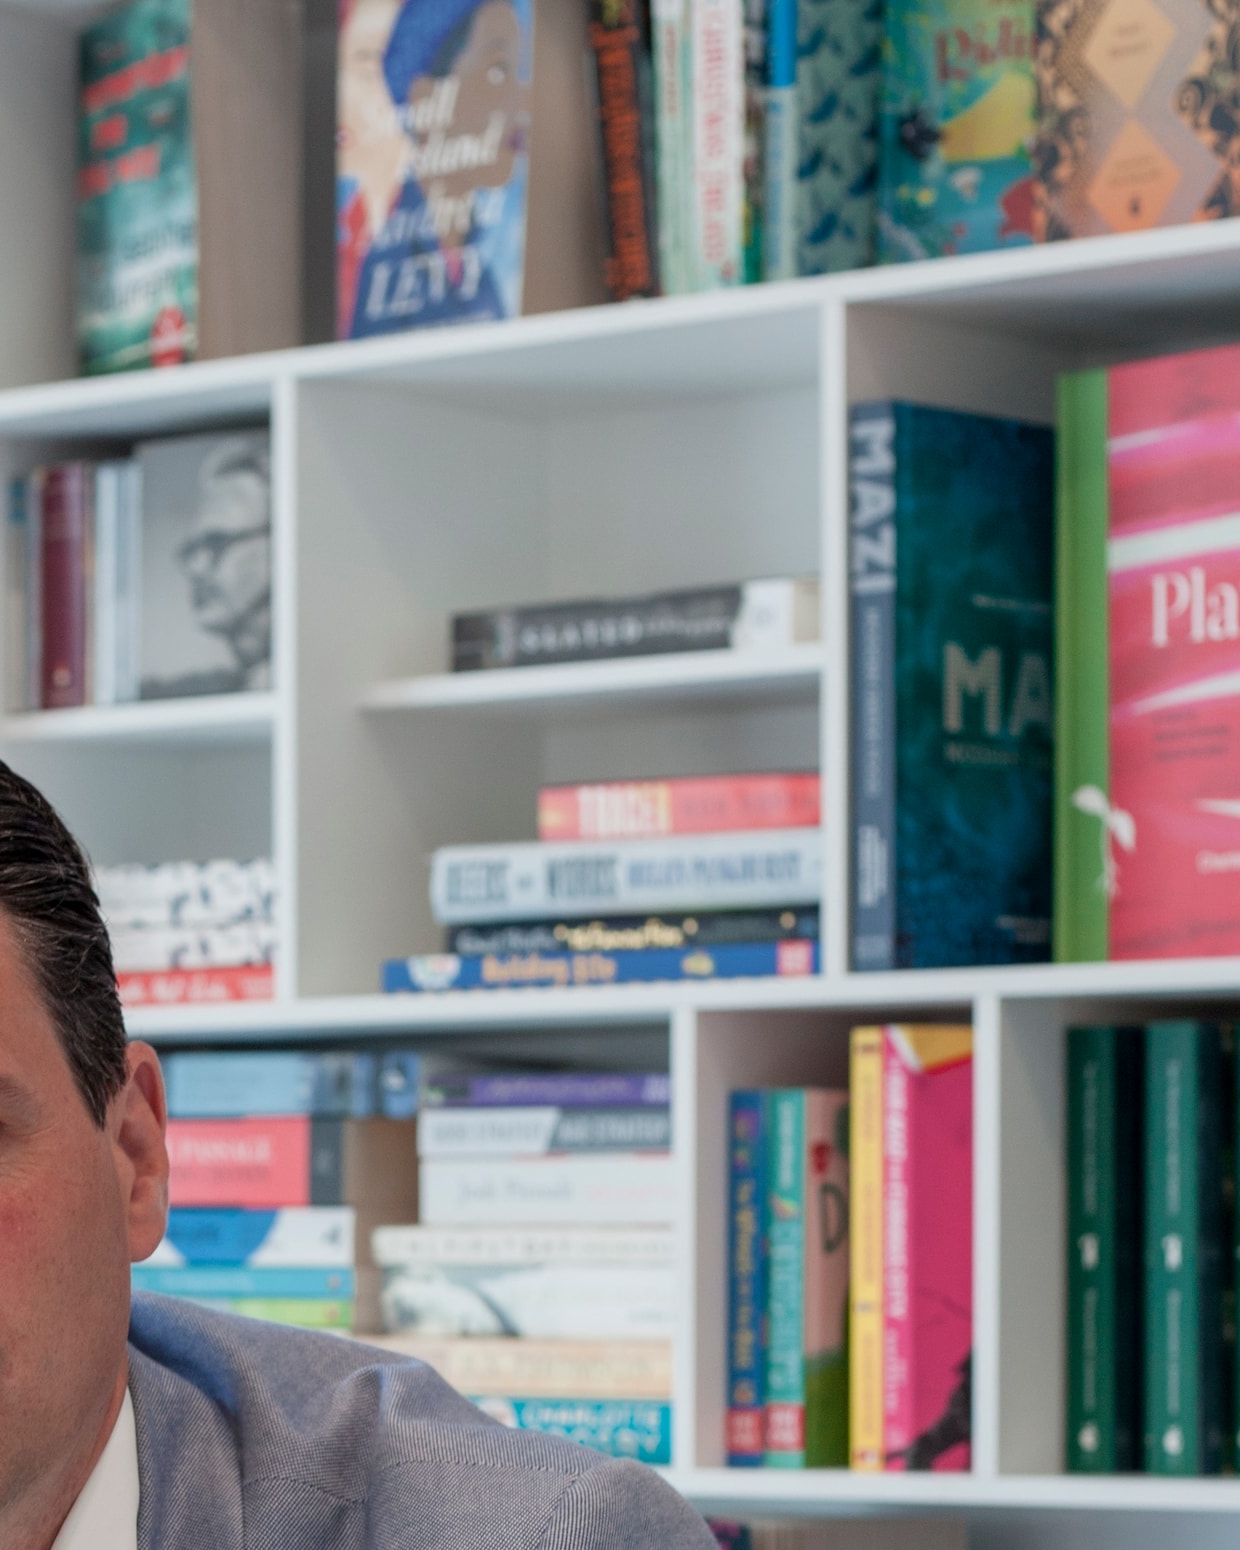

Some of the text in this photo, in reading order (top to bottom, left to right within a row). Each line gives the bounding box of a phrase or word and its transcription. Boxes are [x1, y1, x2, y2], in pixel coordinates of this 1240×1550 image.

[367, 247, 483, 320] LEVY
[853, 416, 897, 593] MAZI
[1151, 566, 1240, 648] Pla
